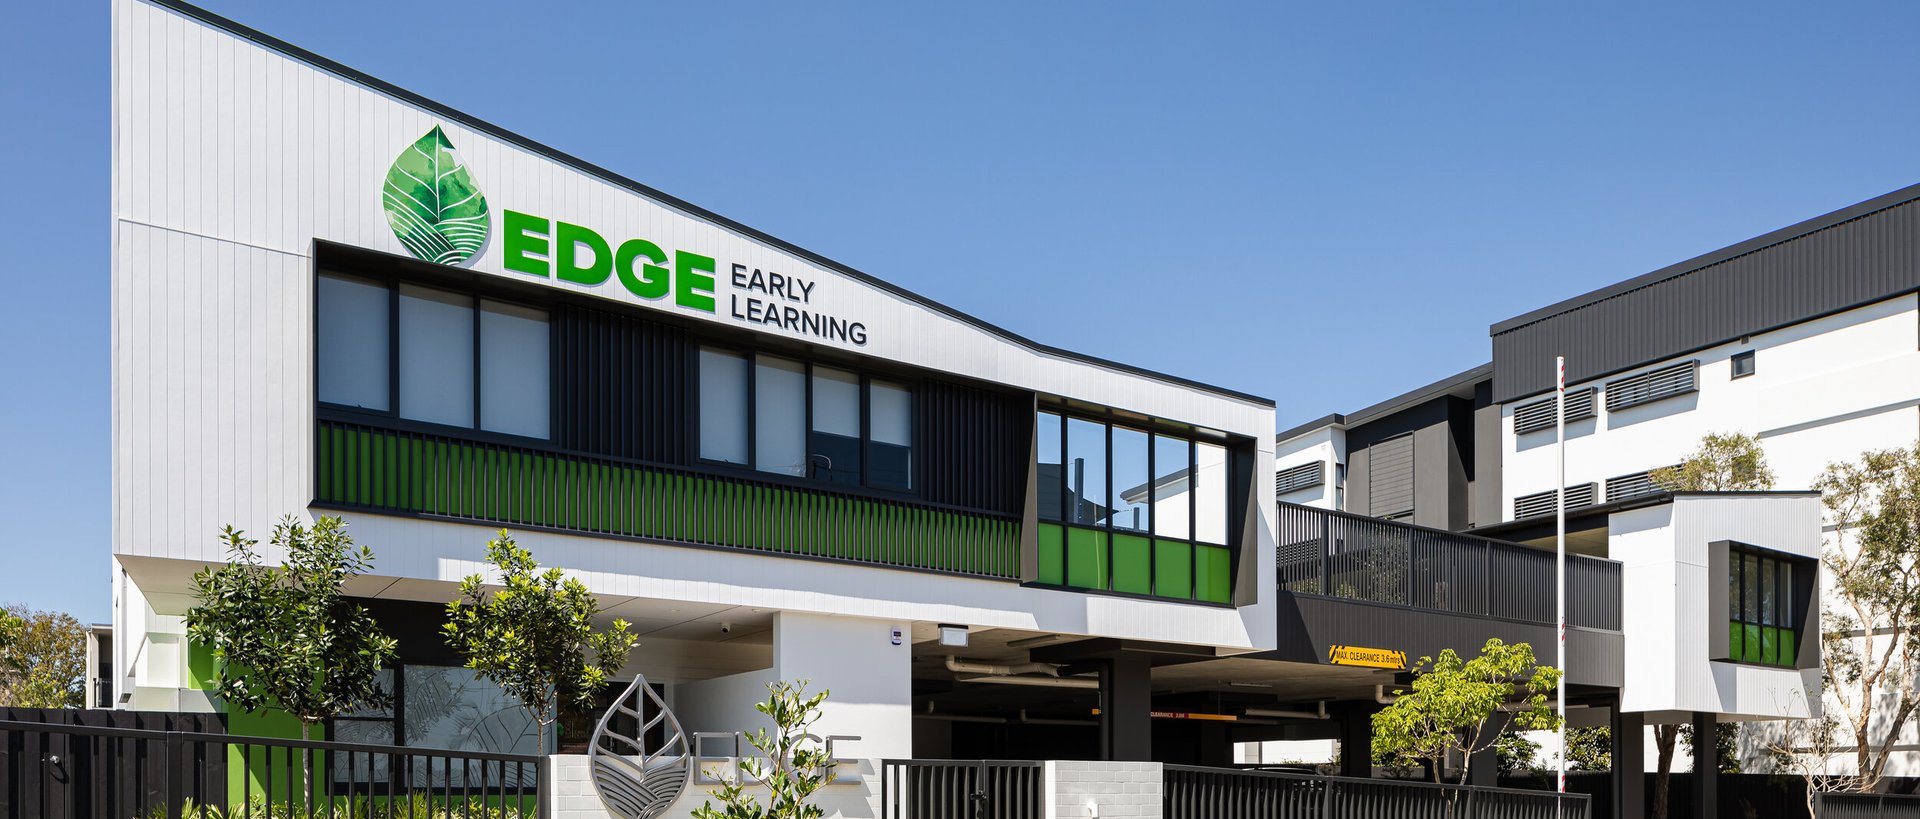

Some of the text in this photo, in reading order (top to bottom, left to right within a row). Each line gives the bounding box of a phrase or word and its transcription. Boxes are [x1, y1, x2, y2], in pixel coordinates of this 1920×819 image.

[504, 209, 715, 313] EDGE
[732, 263, 814, 303] EARLY
[732, 294, 867, 345] LEARNING
[1336, 650, 1348, 660] MAX.
[1350, 651, 1380, 662] CLEARANCE
